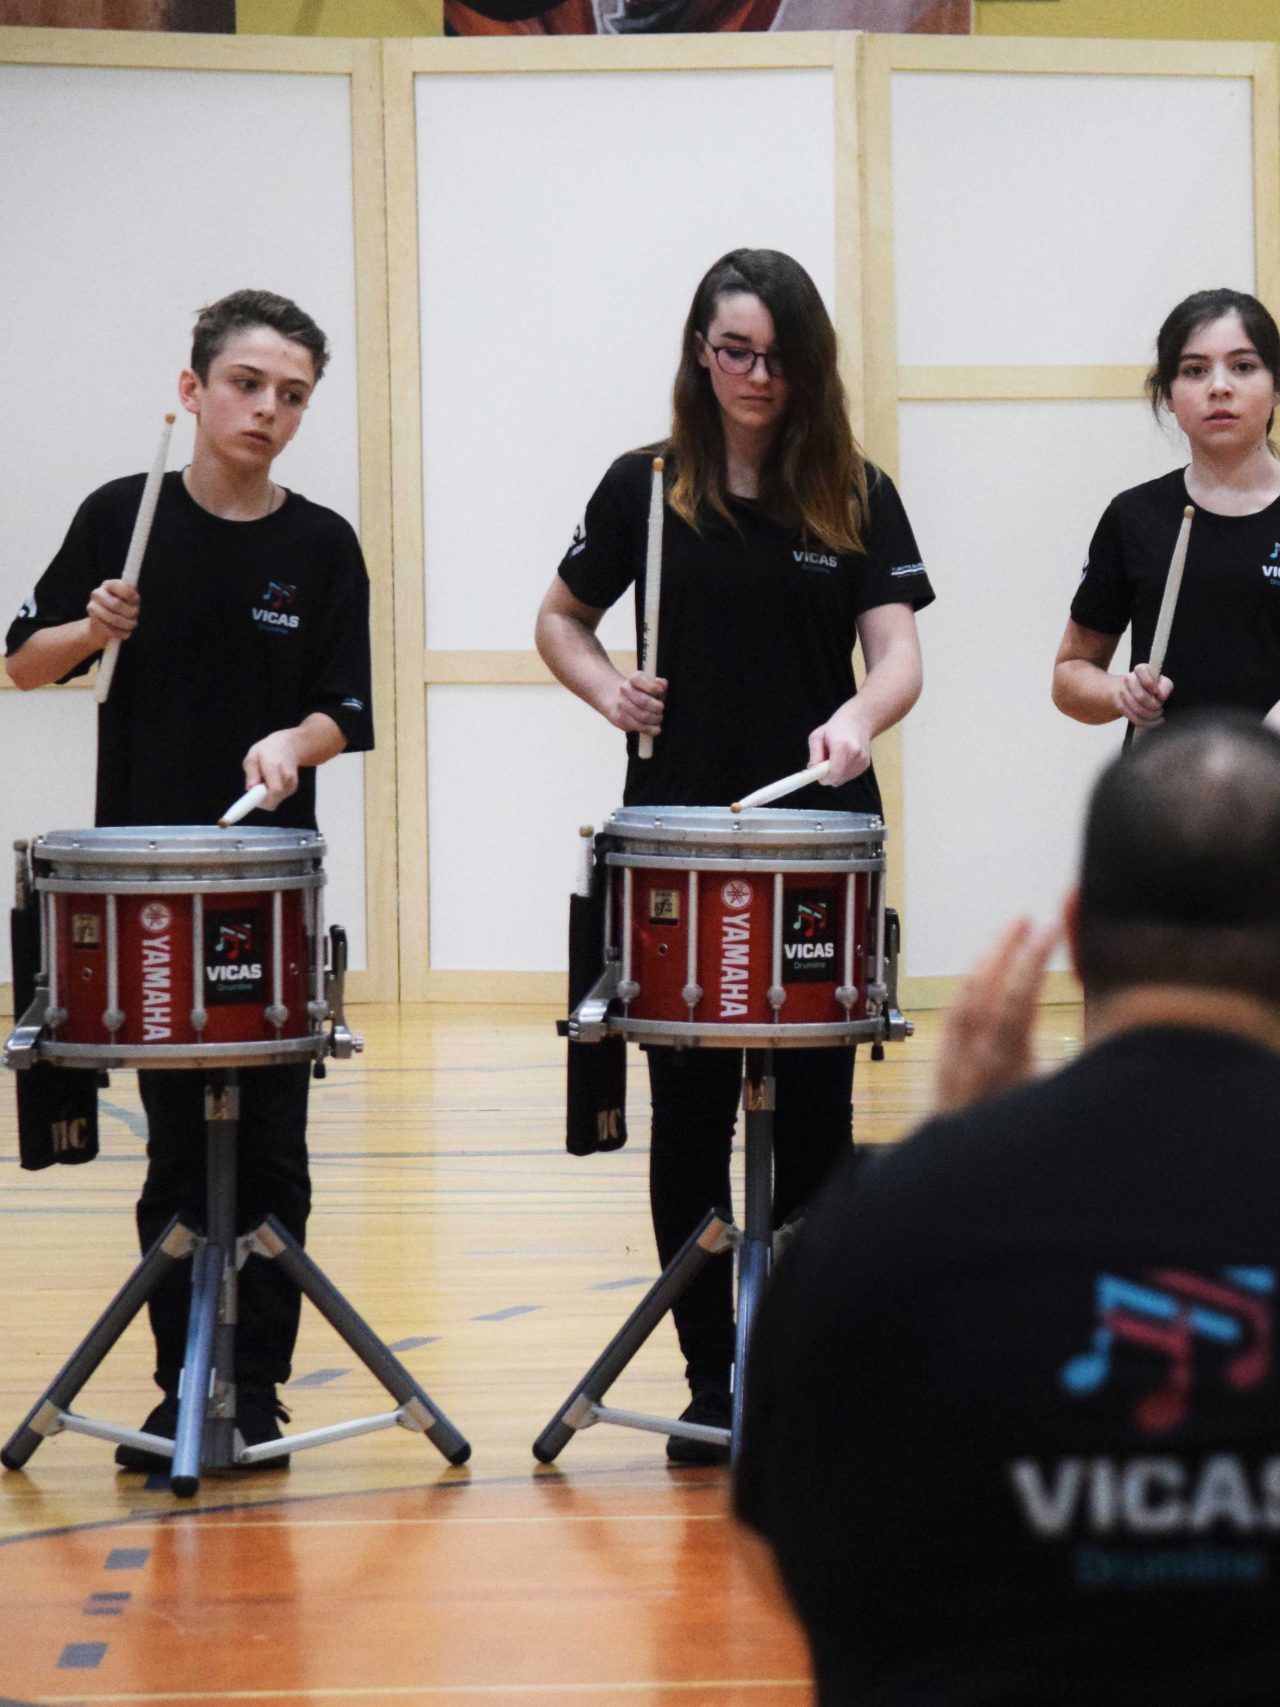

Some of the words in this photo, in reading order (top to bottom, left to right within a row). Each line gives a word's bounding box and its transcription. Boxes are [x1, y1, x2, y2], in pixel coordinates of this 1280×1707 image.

[792, 550, 838, 569] VICAS
[251, 607, 300, 629] VICAS
[784, 942, 835, 959] VICAS
[206, 963, 263, 982] VICAS
[720, 912, 751, 1019] YAMAHA
[141, 936, 173, 1043] YAMAHA
